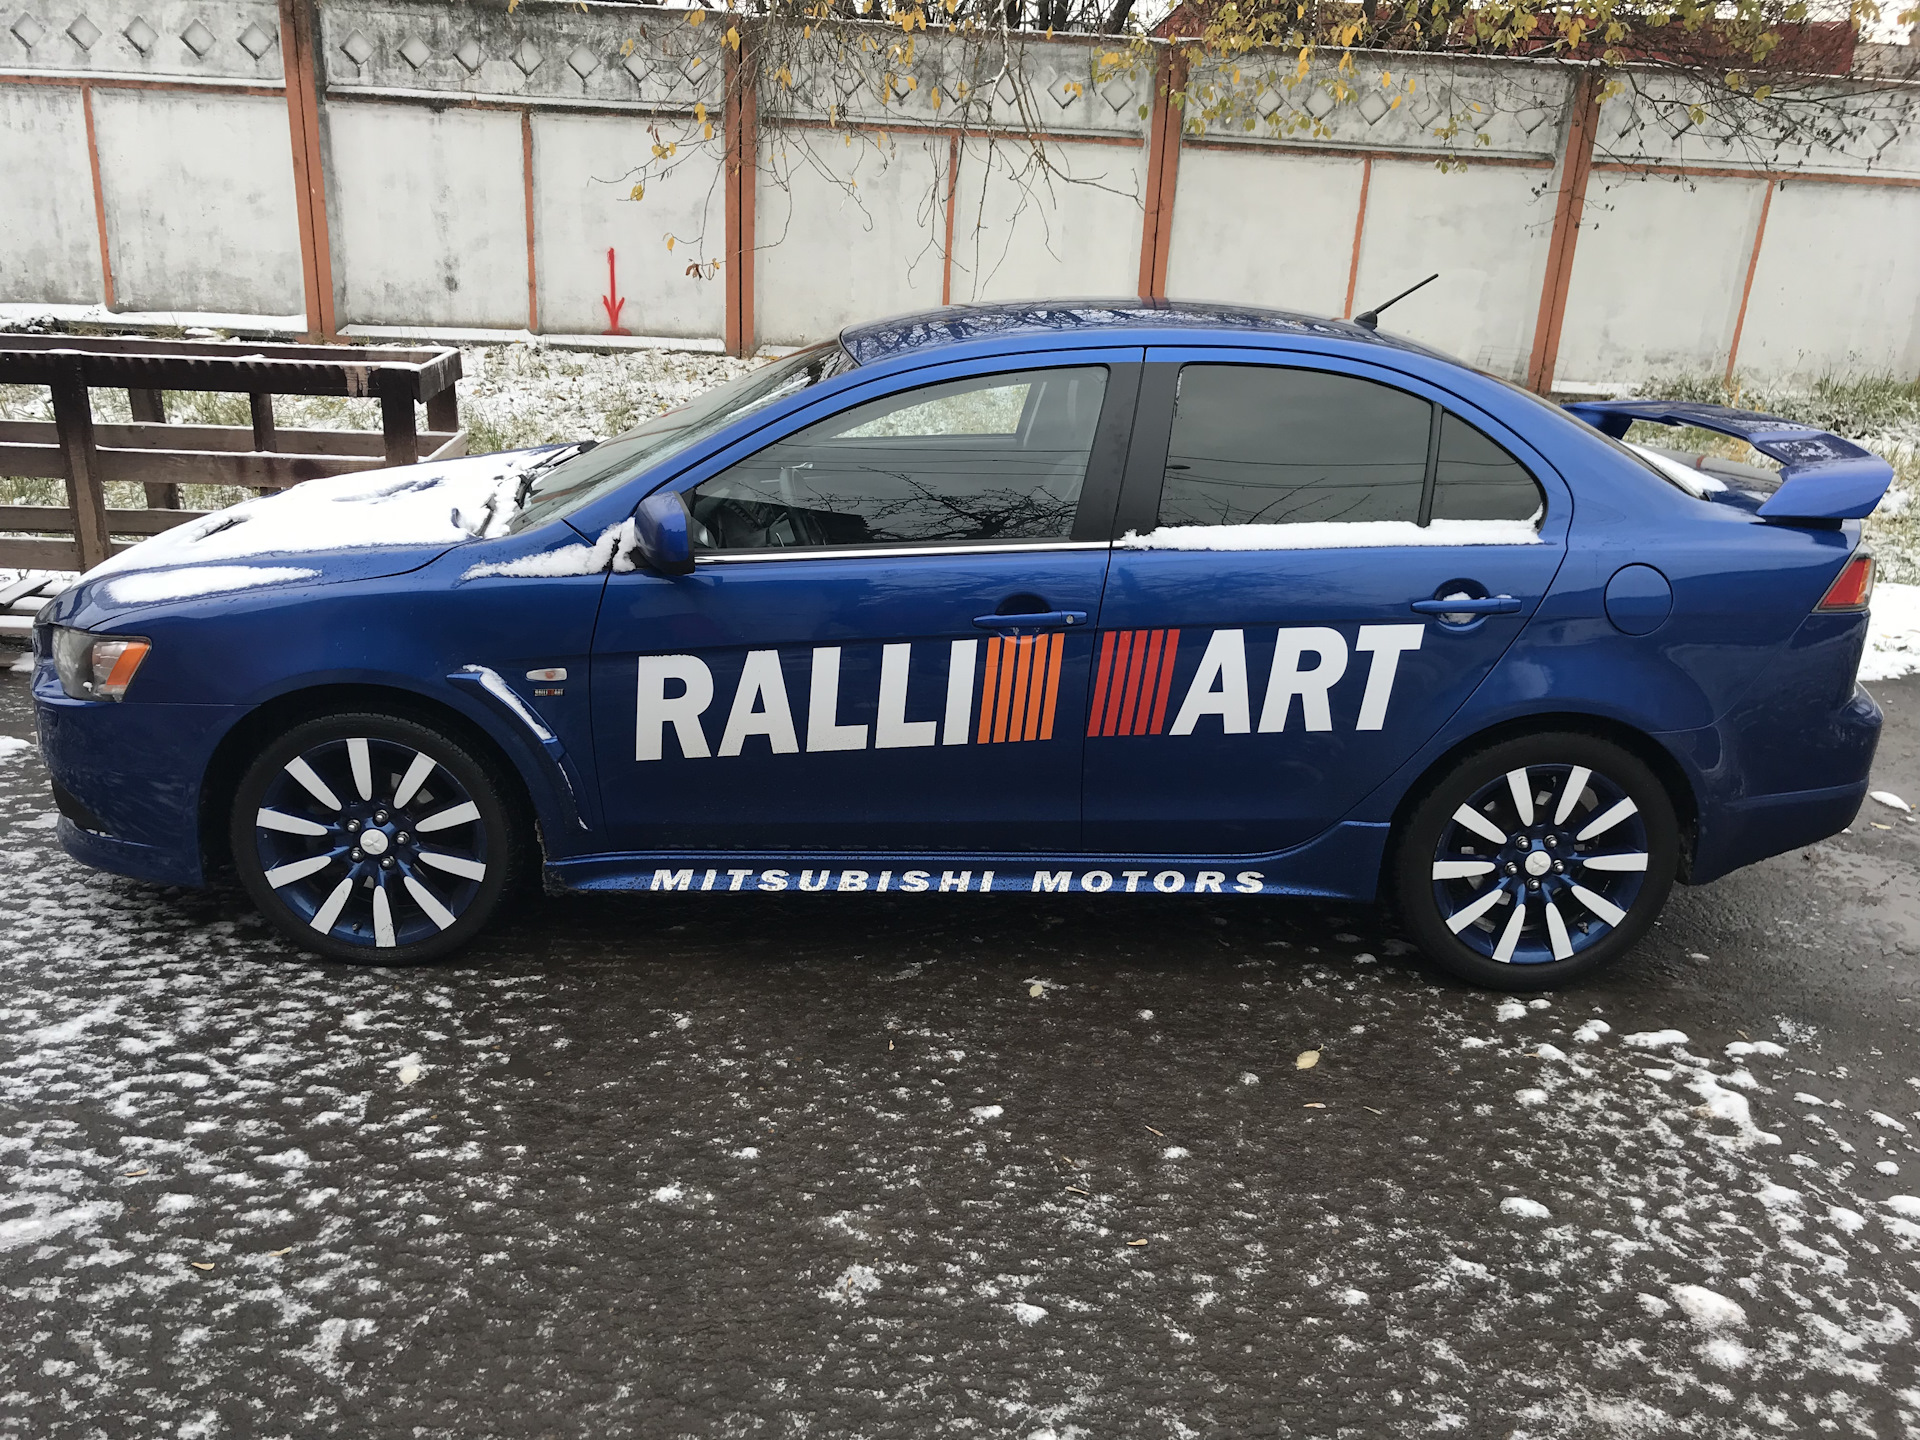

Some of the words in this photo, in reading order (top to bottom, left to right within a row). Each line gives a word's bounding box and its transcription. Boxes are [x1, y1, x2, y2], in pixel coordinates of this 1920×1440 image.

[635, 640, 978, 761] RALLI
[1169, 625, 1425, 736] ART
[650, 868, 995, 893] MITSUBISHI
[1031, 870, 1266, 893] MOTORS
